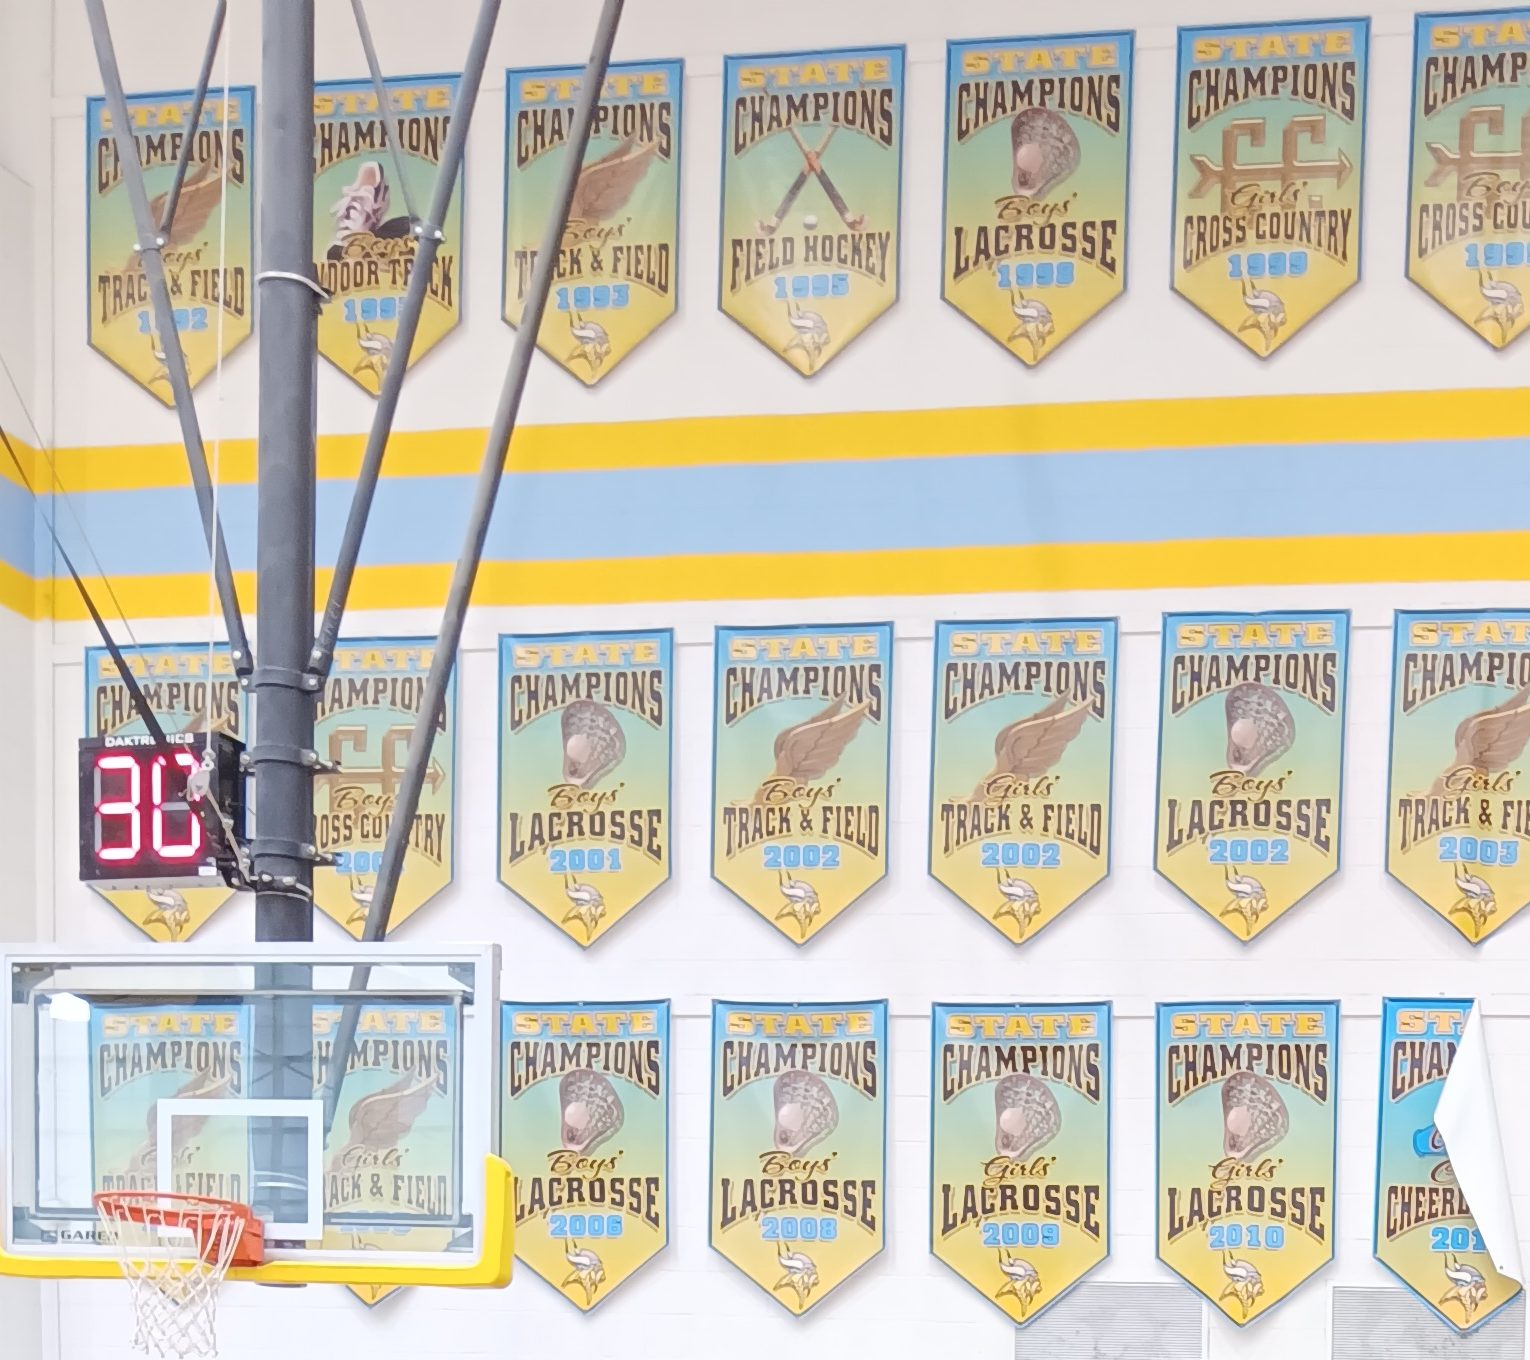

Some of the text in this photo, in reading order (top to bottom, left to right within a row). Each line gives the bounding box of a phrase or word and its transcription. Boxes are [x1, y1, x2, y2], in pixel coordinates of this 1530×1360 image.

[963, 43, 1117, 74] STATE
[1194, 32, 1351, 60] STATE
[739, 60, 888, 89] STATE
[1188, 62, 1356, 130] CHAMPIONS
[734, 89, 894, 155] CHAMPIONS
[957, 74, 1121, 141] CHAMPIONS
[953, 220, 1117, 280] LACROSSE
[1183, 209, 1352, 271] CROSS COUNTRY
[1418, 202, 1484, 258] CROSS
[612, 243, 670, 294] FIELD
[730, 231, 891, 292] FIELD HOCKEY
[774, 274, 850, 299] 1995
[1229, 251, 1307, 279] 1999
[190, 266, 244, 316] FIELD
[556, 283, 630, 311] 1993
[514, 641, 659, 667] STATE
[731, 635, 878, 660] STATE
[951, 631, 1104, 655] STATE
[1177, 623, 1333, 647] STATE
[510, 670, 663, 732] CHAMPIONS
[725, 664, 882, 726] CHAMPIONS
[944, 660, 1107, 721] CHAMPIONS
[1171, 652, 1338, 716] CHAMPIONS
[509, 809, 662, 864] LACROSSE
[723, 805, 880, 857] TRACK FIELD
[941, 803, 1102, 857] TRACK FIELD
[1166, 798, 1331, 854] LACROSSE
[1399, 798, 1470, 851] TRACK
[549, 848, 622, 872] 2001
[763, 845, 841, 869] 2002
[981, 843, 1061, 867] 2002
[1209, 839, 1289, 864] 2002
[1439, 836, 1520, 864] 2003
[104, 1013, 239, 1036] STATE
[513, 1012, 657, 1035] STATE
[726, 1012, 874, 1036] STATE
[948, 1014, 1096, 1037] STATE
[1172, 1013, 1324, 1037] STATE
[100, 1040, 242, 1096] CHAMPIONS
[510, 1040, 660, 1098] CHAMPIONS
[722, 1040, 877, 1099] CHAMPIONS
[942, 1043, 1100, 1103] CHAMPIONS
[1167, 1043, 1328, 1104] CHAMPIONS
[370, 1173, 446, 1215] & FIELD
[515, 1177, 660, 1230] LACROSSE
[721, 1178, 876, 1232] LACROSSE
[941, 1184, 1100, 1240] LACROSSE
[1167, 1187, 1326, 1242] LACROSSE
[549, 1214, 623, 1238] 2006
[761, 1216, 838, 1240] 2008
[983, 1223, 1060, 1246] 2009
[1209, 1224, 1285, 1249] 2010
